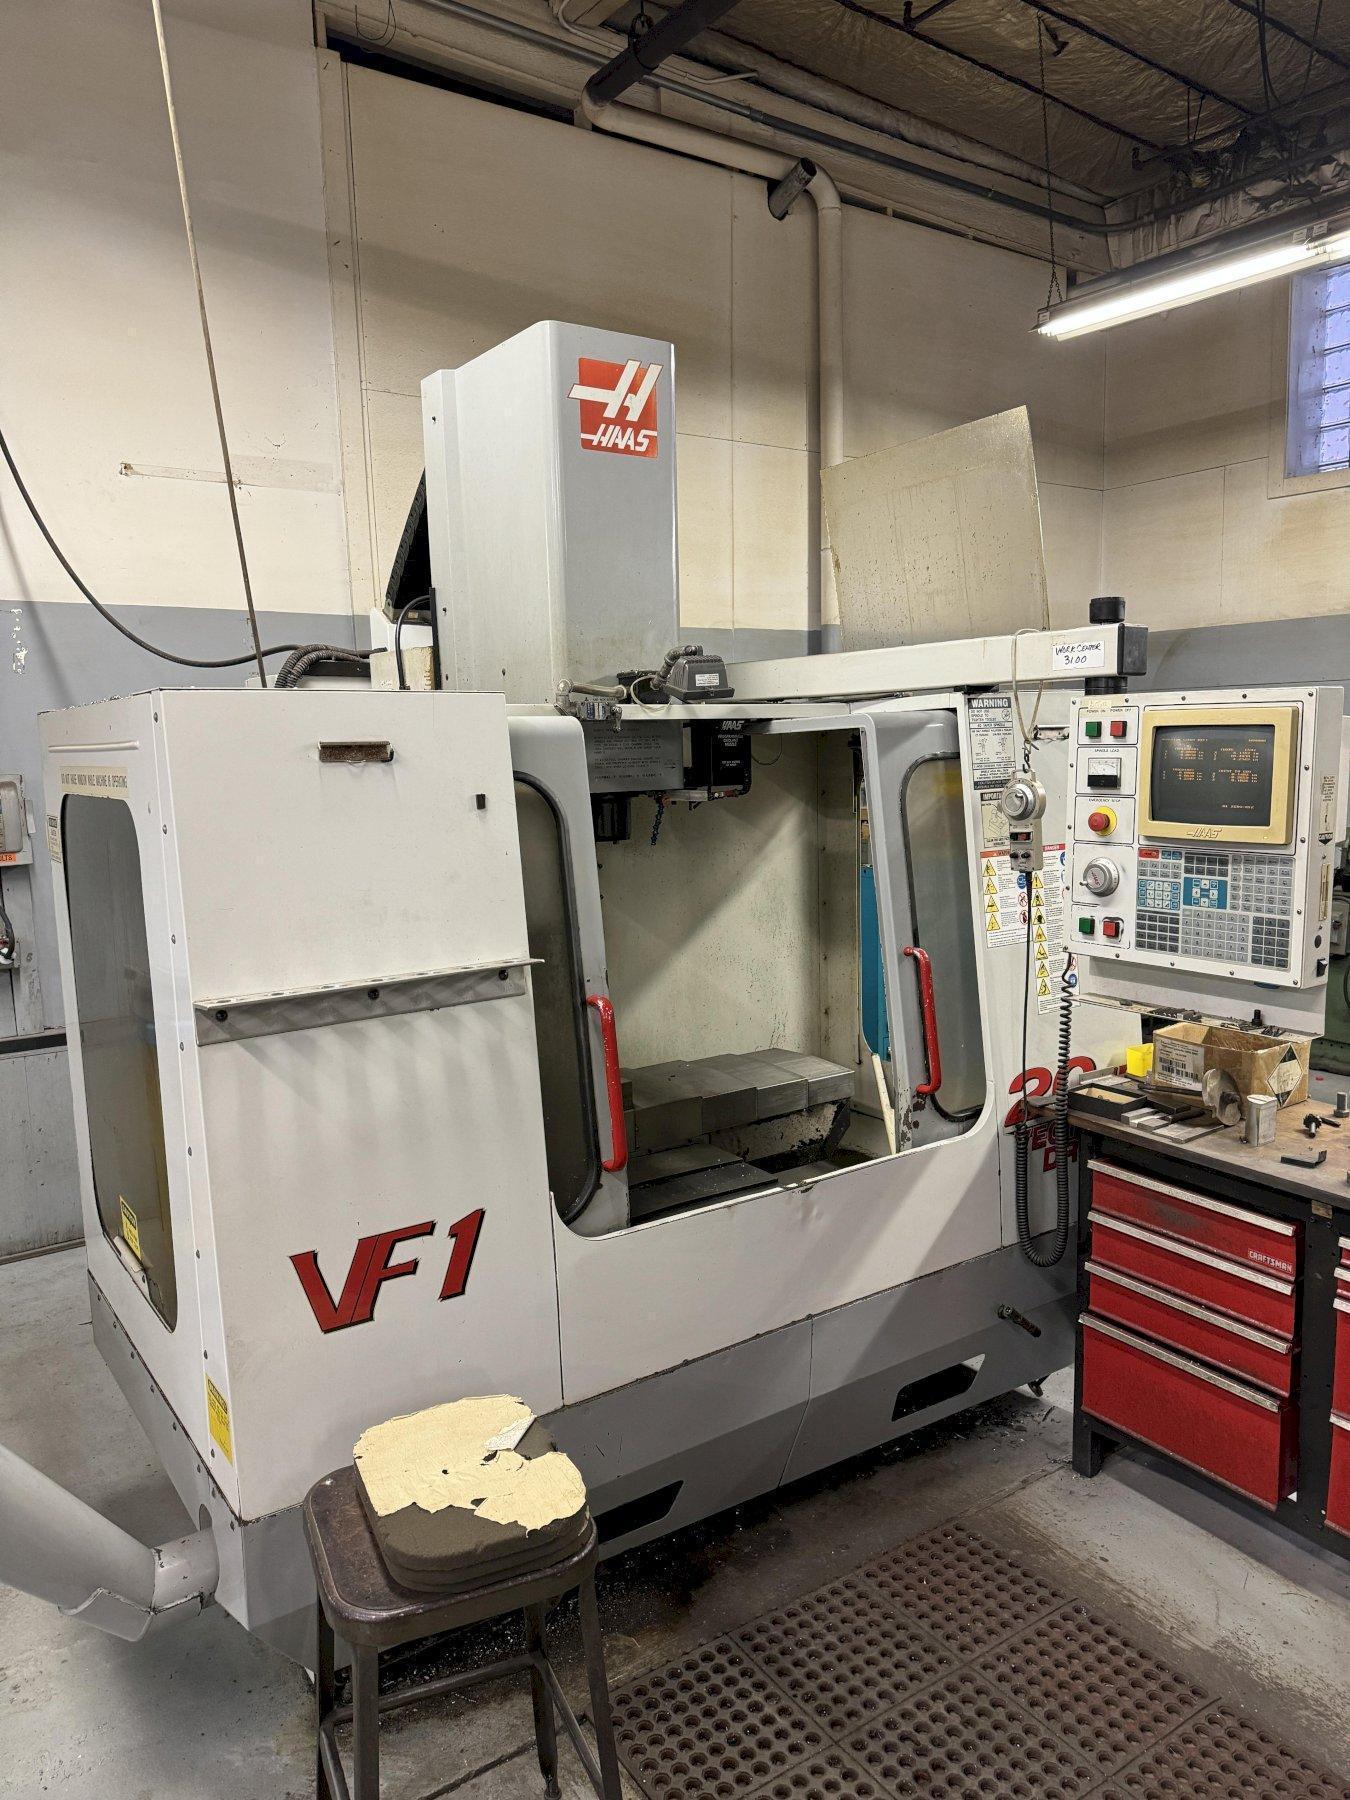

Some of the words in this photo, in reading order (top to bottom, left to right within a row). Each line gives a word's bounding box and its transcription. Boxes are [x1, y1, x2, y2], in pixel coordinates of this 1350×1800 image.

[580, 423, 658, 452] HAAS
[1055, 646, 1076, 656] WORK
[1076, 642, 1102, 653] CENTER
[971, 698, 1009, 708] WARNING
[721, 720, 745, 730] HAAS
[1186, 827, 1223, 838] HAAS
[1248, 1250, 1293, 1273] CRAFTSMAN
[289, 1208, 487, 1334] VF1
